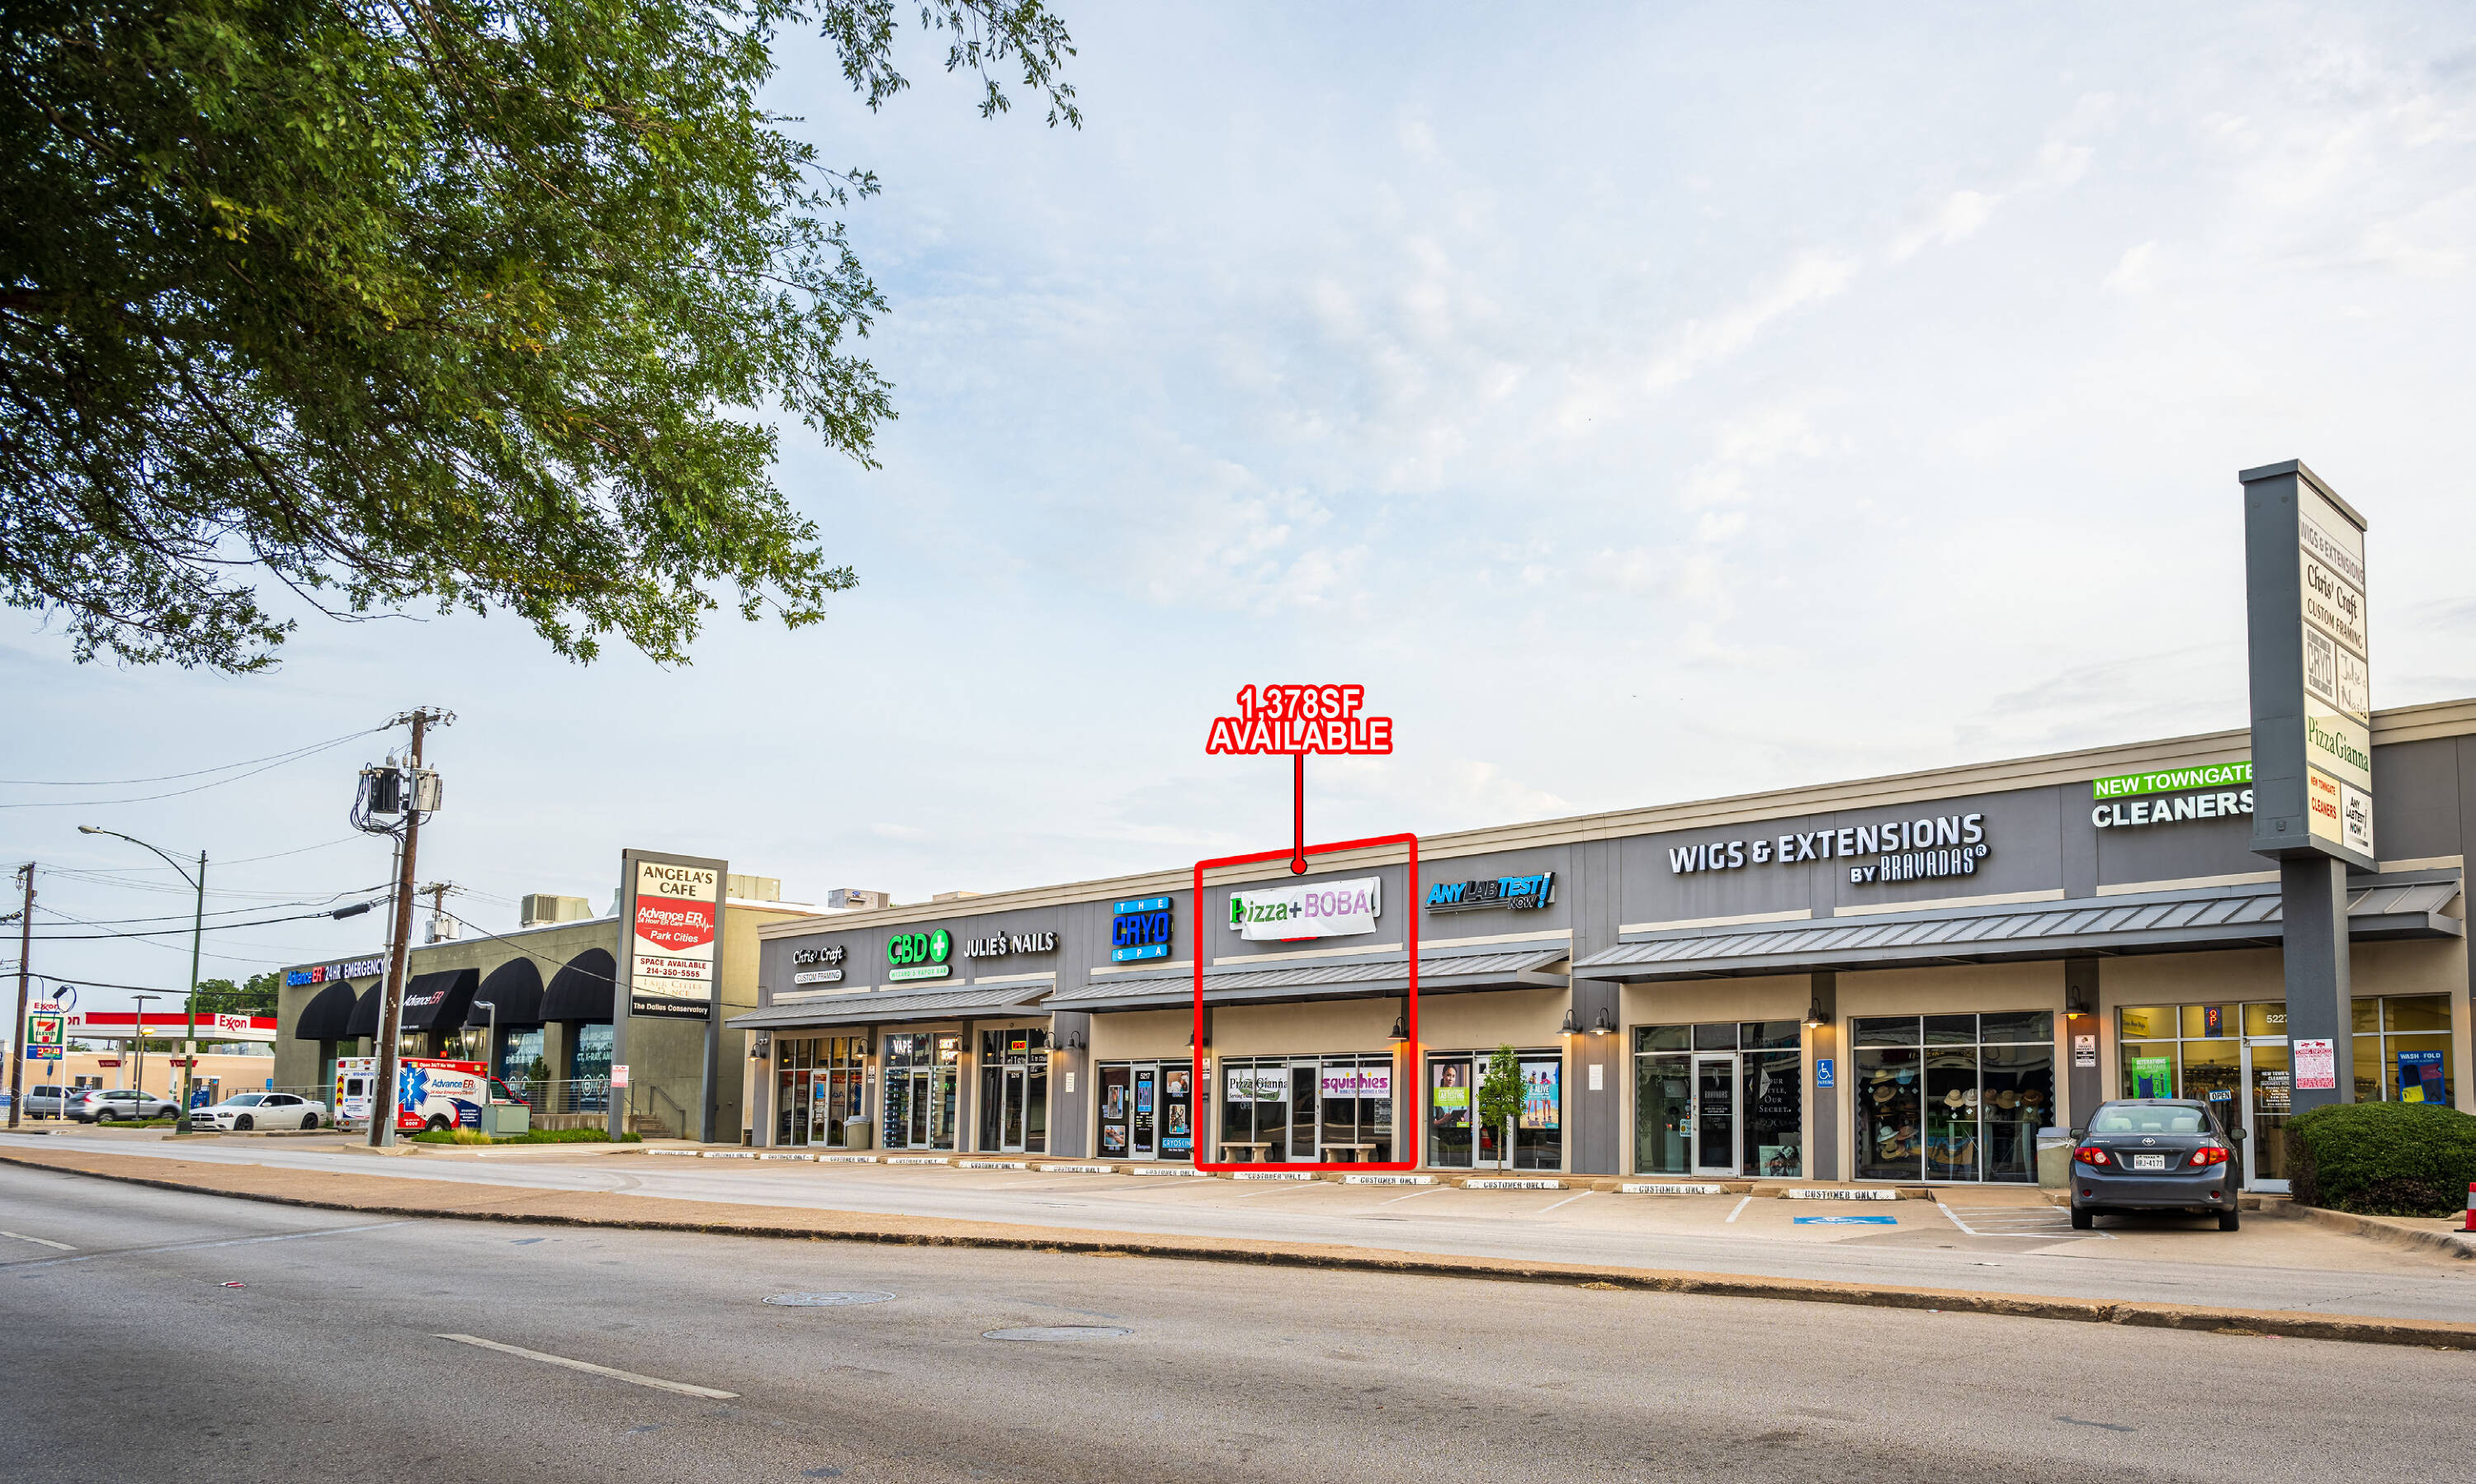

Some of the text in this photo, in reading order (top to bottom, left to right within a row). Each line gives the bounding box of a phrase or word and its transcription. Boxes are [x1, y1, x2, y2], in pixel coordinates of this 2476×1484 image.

[2300, 521, 2318, 549] WIGS
[2324, 540, 2364, 585] EXTENSIONS
[2337, 586, 2358, 625] Craft
[2308, 598, 2363, 650] CUSTOM FRAMING
[2308, 641, 2332, 686] CRYO
[2341, 685, 2367, 719] Nails
[2096, 764, 2252, 796] NEW TOWNGATE
[2318, 779, 2336, 796] TOWNGATE
[2091, 789, 2253, 828] CLEANERS
[2311, 796, 2337, 820] CLEANERS
[2351, 796, 2360, 810] ANY
[2350, 821, 2362, 835] NOW
[1669, 813, 1982, 874] WIGS & EXTENSIONS
[644, 866, 713, 885] ANGELA'S
[1850, 865, 1876, 883] BY
[659, 881, 697, 896] CAFE
[638, 906, 684, 921] Advance
[1119, 899, 1163, 912] THE
[650, 930, 698, 943] Park Cities
[1113, 913, 1169, 946] CRYO
[964, 930, 1055, 957] JULIE'S NAILS
[820, 945, 843, 966] Craft
[1118, 946, 1161, 959] SPA
[343, 958, 385, 979] EMERGENCY
[640, 957, 706, 969] SPACE AVAILABLE
[646, 967, 700, 977] 214-350-5555
[797, 971, 840, 982] CUSTOM FRAMING
[35, 1002, 59, 1010] Exxon
[668, 1005, 708, 1015] Conservatory
[220, 1015, 247, 1032] Exxon
[2266, 1014, 2288, 1023] 5227
[893, 1040, 911, 1054] VAPE
[1230, 1076, 1288, 1089] Pizza Gianna
[1322, 1071, 1388, 1093] squishies
[1484, 1181, 1523, 1190] CUSTOMER
[1804, 1190, 1850, 1201] CUSTOMER
